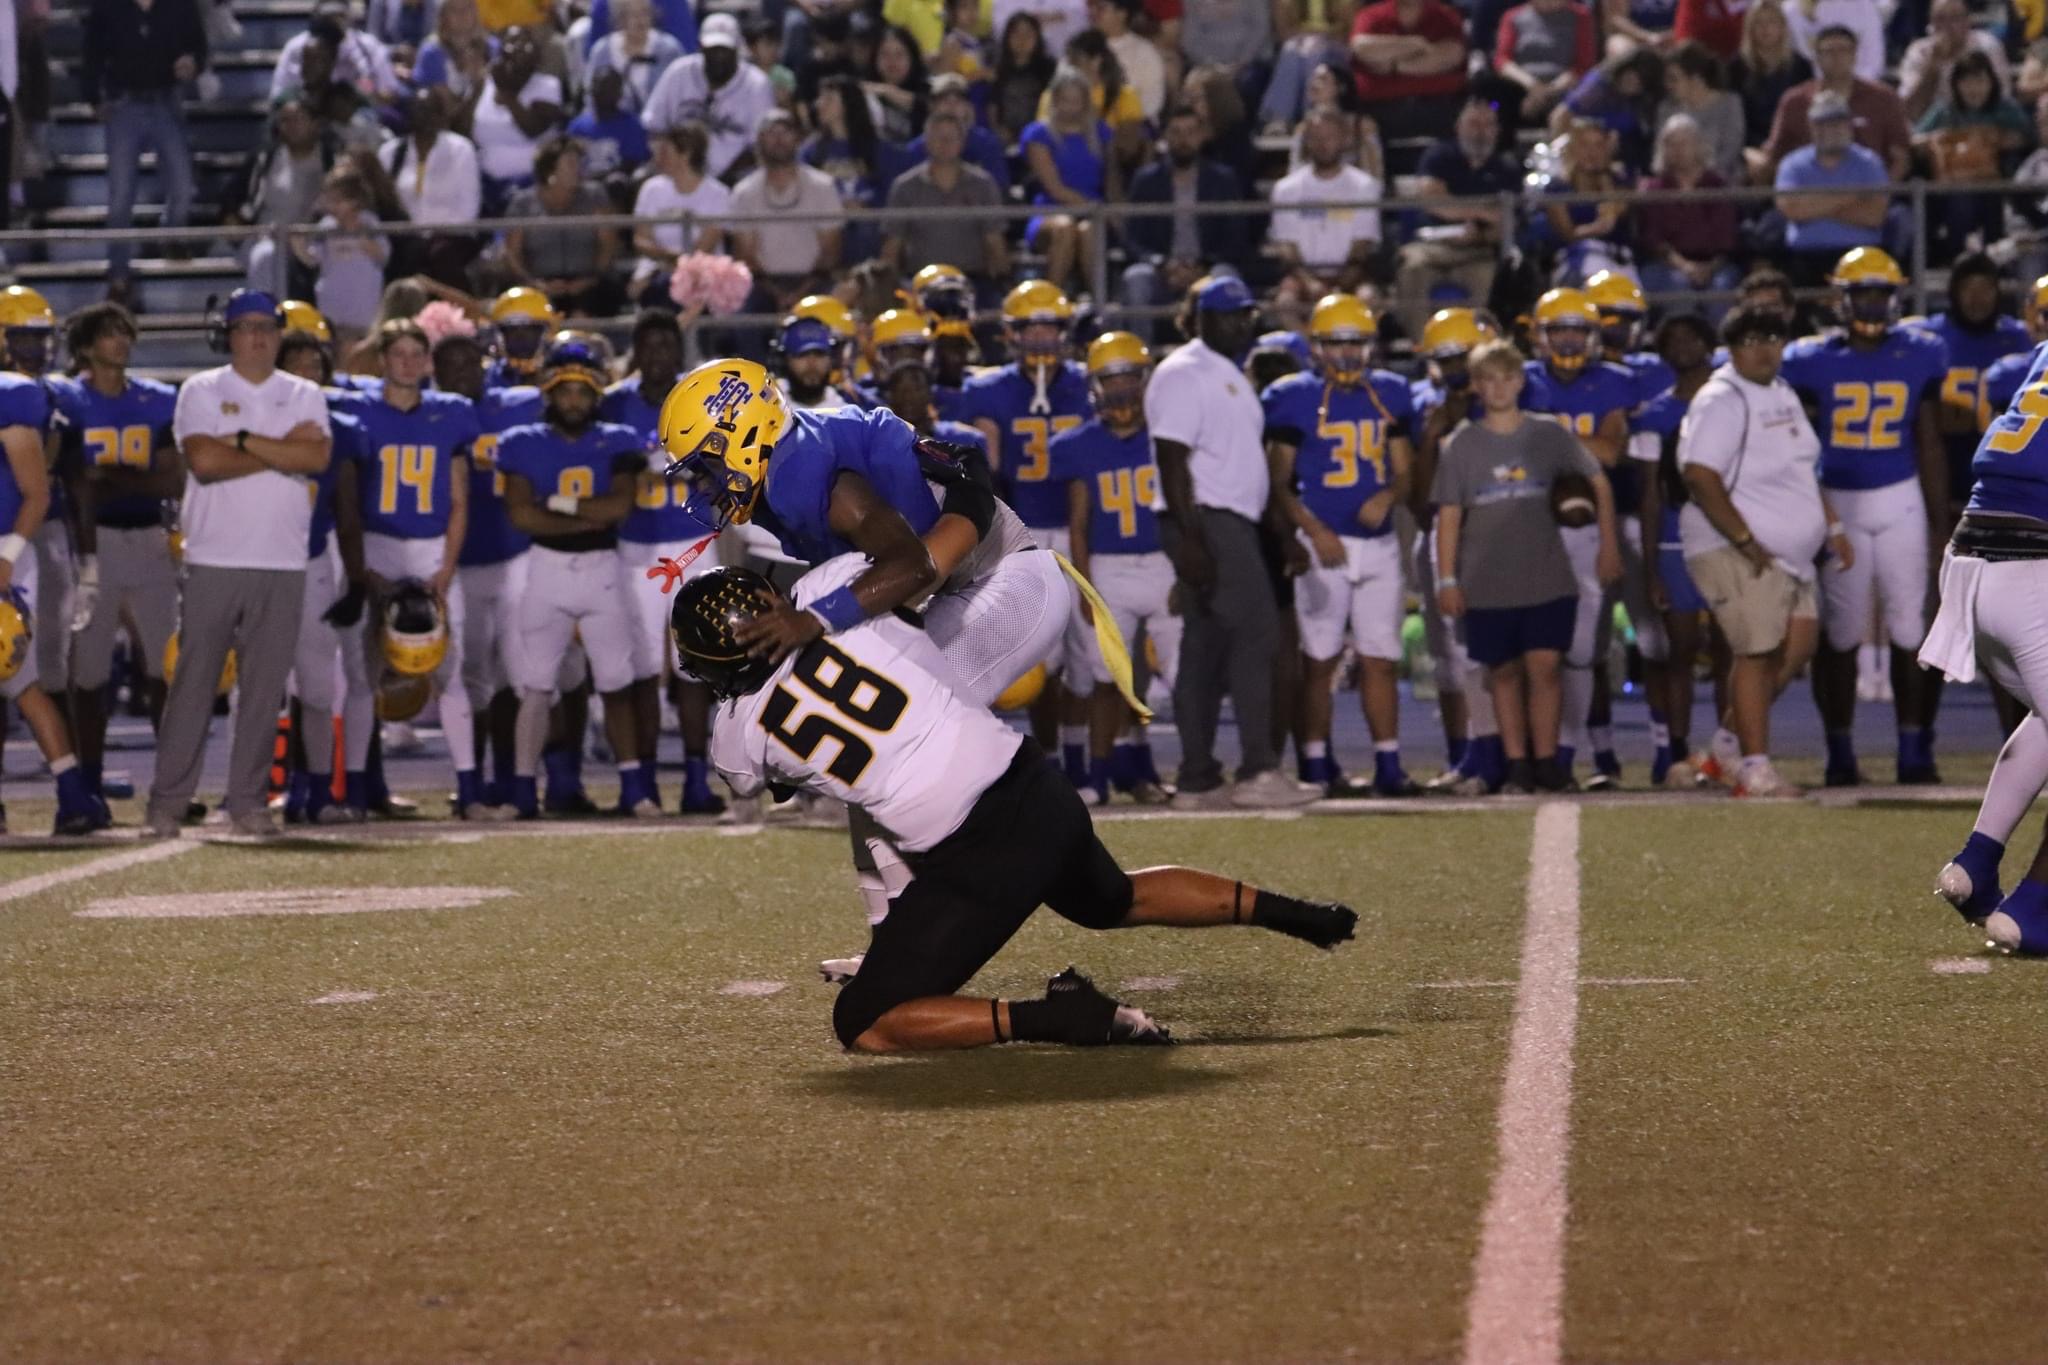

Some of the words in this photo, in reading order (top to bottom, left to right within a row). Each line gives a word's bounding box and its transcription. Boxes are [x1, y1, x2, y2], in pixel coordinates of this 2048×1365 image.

[1013, 415, 1082, 481] 3
[1830, 381, 1908, 448] 22
[379, 445, 436, 514] 14
[1319, 419, 1386, 487] 34
[757, 635, 912, 788] 58
